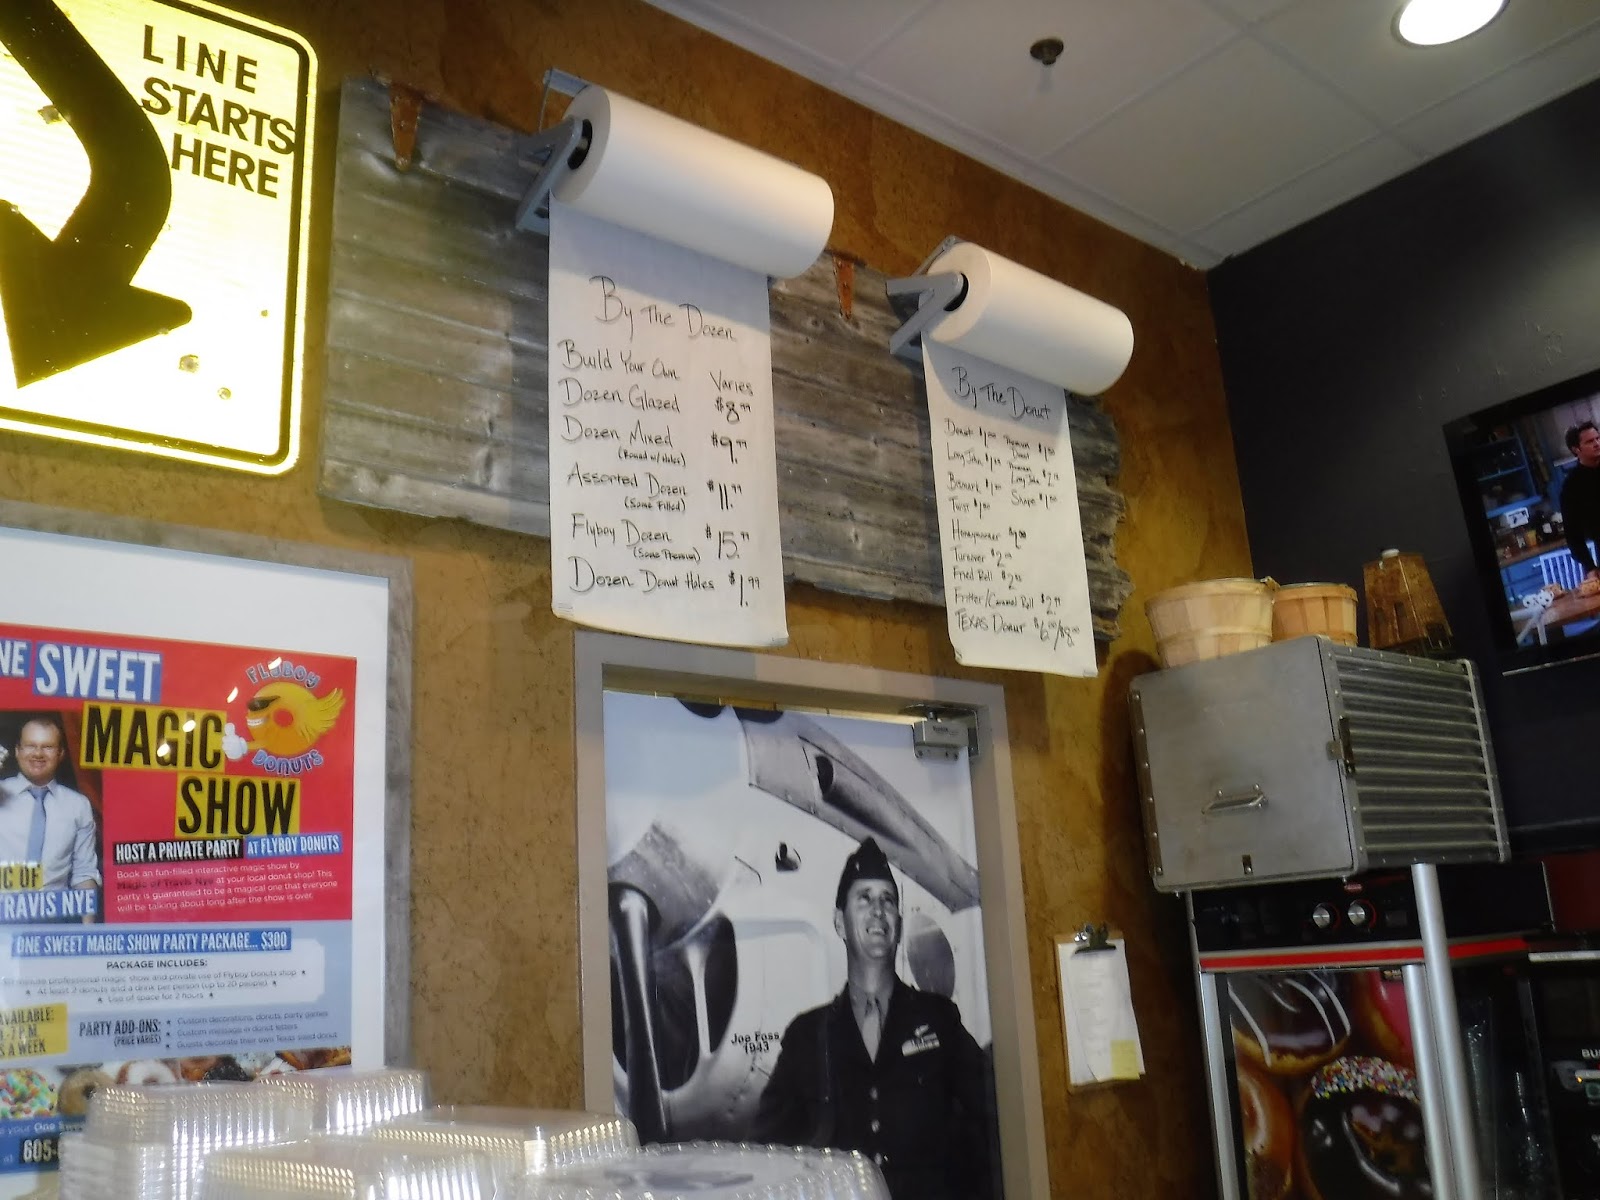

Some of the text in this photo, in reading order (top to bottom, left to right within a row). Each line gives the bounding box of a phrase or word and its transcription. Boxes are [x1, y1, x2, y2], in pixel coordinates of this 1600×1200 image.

[143, 24, 258, 94] LINE
[140, 77, 296, 155] STARTS
[171, 132, 279, 199] HERE
[589, 275, 738, 343] By The Dozen
[557, 339, 681, 382] Build Your Own
[558, 377, 681, 413] Dozen Glazed
[710, 371, 754, 396] Varies
[952, 366, 1052, 420] By The Donut
[561, 415, 620, 442] Dozen
[630, 419, 674, 448] Mixed
[944, 417, 974, 438] Donut
[567, 462, 638, 488] Assorted
[645, 472, 687, 499] Dozen
[571, 513, 616, 548] Flyboy
[621, 519, 673, 547] Dozen
[568, 555, 760, 608] Dozen Donut Holes $1.99
[955, 608, 990, 632] TEXAS
[36, 643, 161, 703] SWEET
[84, 703, 224, 770] MAGIC
[252, 749, 324, 776] DONUTS
[178, 777, 298, 835] SHOW
[116, 835, 340, 862] HOST A PRIVATE PARTY AT FLYBOY DONUTS
[20, 864, 41, 888] OF
[117, 870, 140, 879] Book
[155, 867, 193, 876] fun-filled
[195, 865, 239, 875] interactive
[240, 863, 265, 872] magic
[267, 862, 288, 870] show
[289, 861, 300, 870] by
[227, 876, 245, 884] your
[62, 889, 95, 916] NYE
[117, 893, 140, 902] party
[152, 888, 201, 900] guaranteed
[234, 885, 266, 894] magical
[302, 880, 338, 889] everyone
[117, 904, 132, 912] will
[148, 901, 178, 910] talking
[180, 899, 204, 907] about
[206, 899, 225, 908] long
[227, 896, 247, 905] after
[263, 893, 285, 901] show
[17, 931, 287, 953] ONE SWEET MAGIC SHOW PARTY PACKAGE... $300
[106, 959, 208, 969] PACKAGE INCLUDES:
[79, 1018, 162, 1037] PARTY ADD-ONS:
[731, 1030, 780, 1044] Joe Foss
[34, 1122, 56, 1134] One
